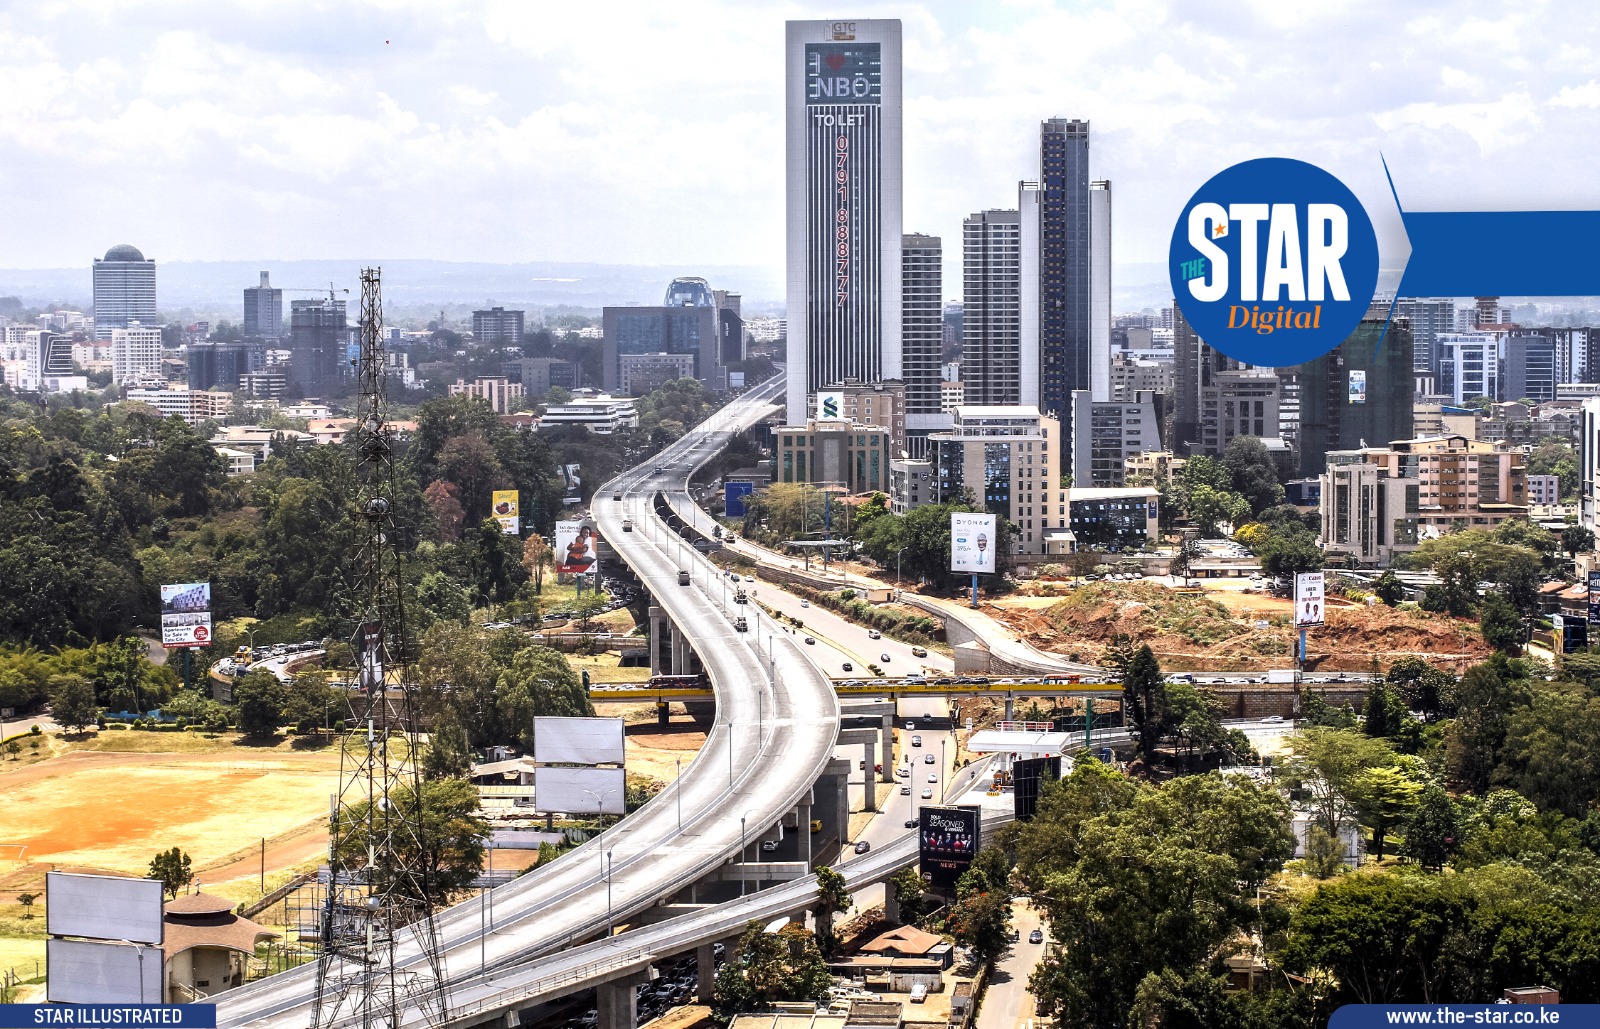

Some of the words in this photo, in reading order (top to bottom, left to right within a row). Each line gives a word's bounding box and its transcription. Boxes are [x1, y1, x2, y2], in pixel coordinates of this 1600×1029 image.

[833, 22, 856, 32] GTC
[816, 77, 871, 97] NBO
[815, 114, 835, 127] TO
[838, 114, 865, 126] LET
[929, 819, 965, 829] SEASONED
